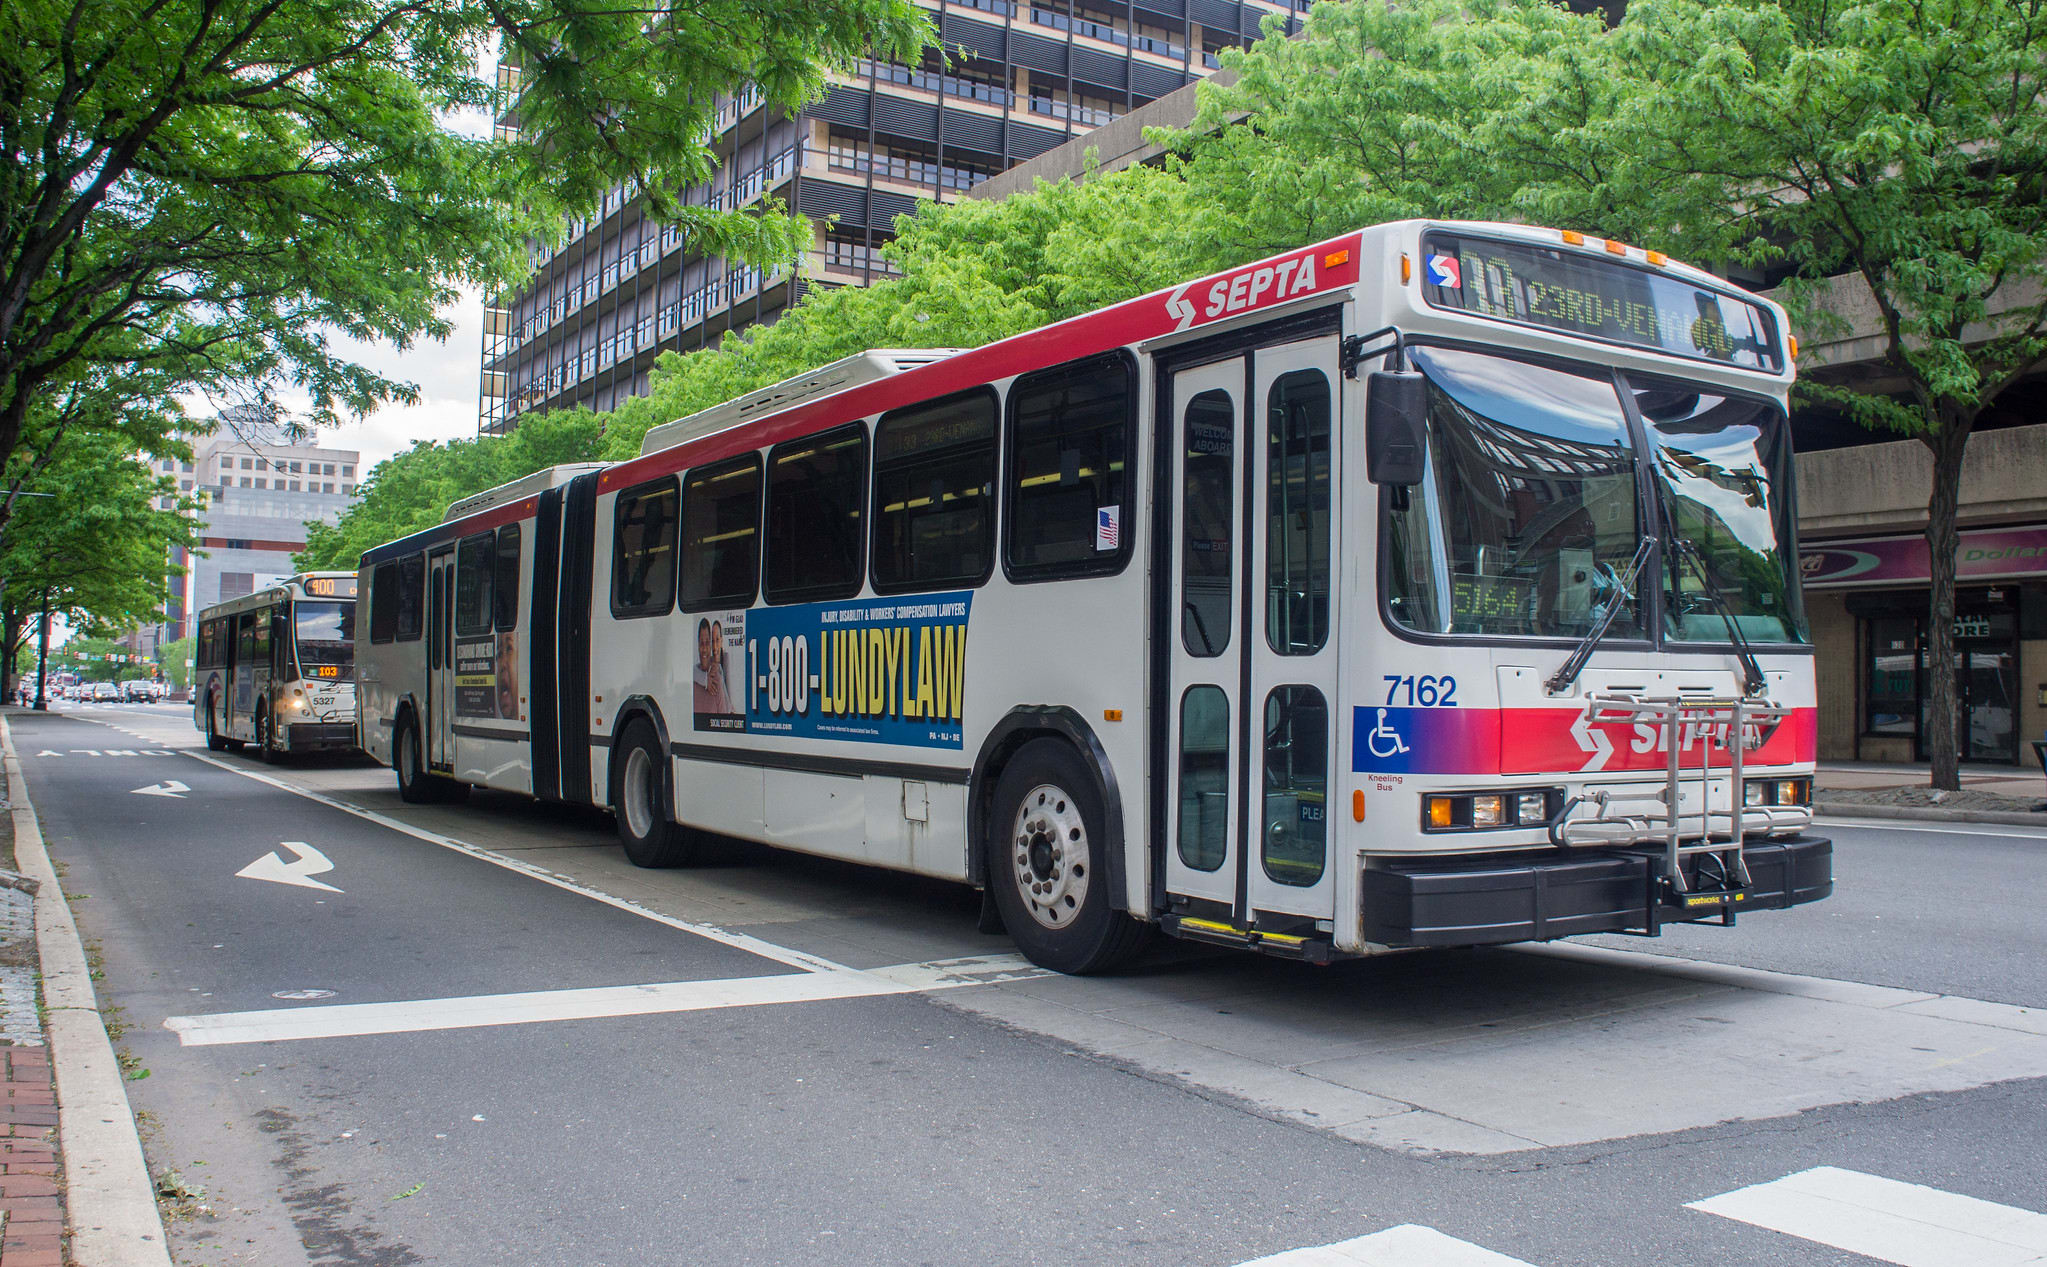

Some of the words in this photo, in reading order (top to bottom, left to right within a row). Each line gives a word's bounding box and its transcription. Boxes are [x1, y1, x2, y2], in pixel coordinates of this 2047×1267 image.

[1205, 254, 1316, 318] SEPTA
[1193, 427, 1232, 440] WELCOM
[1964, 546, 2047, 561] Dollar
[312, 579, 335, 595] 400
[1454, 583, 1518, 616] 5164
[839, 609, 864, 622] DISABILITY
[865, 609, 869, 620] &
[897, 604, 938, 619] COMPENSATION
[939, 602, 966, 617] LAWYERS
[1952, 624, 1989, 636] ORE
[319, 667, 337, 677] 103
[1384, 675, 1457, 707] 7162
[313, 697, 336, 706] 5327
[929, 731, 936, 740] PA
[1368, 773, 1403, 785] Kneeling
[1377, 783, 1393, 791] Bus
[1302, 806, 1324, 821] PLEA
